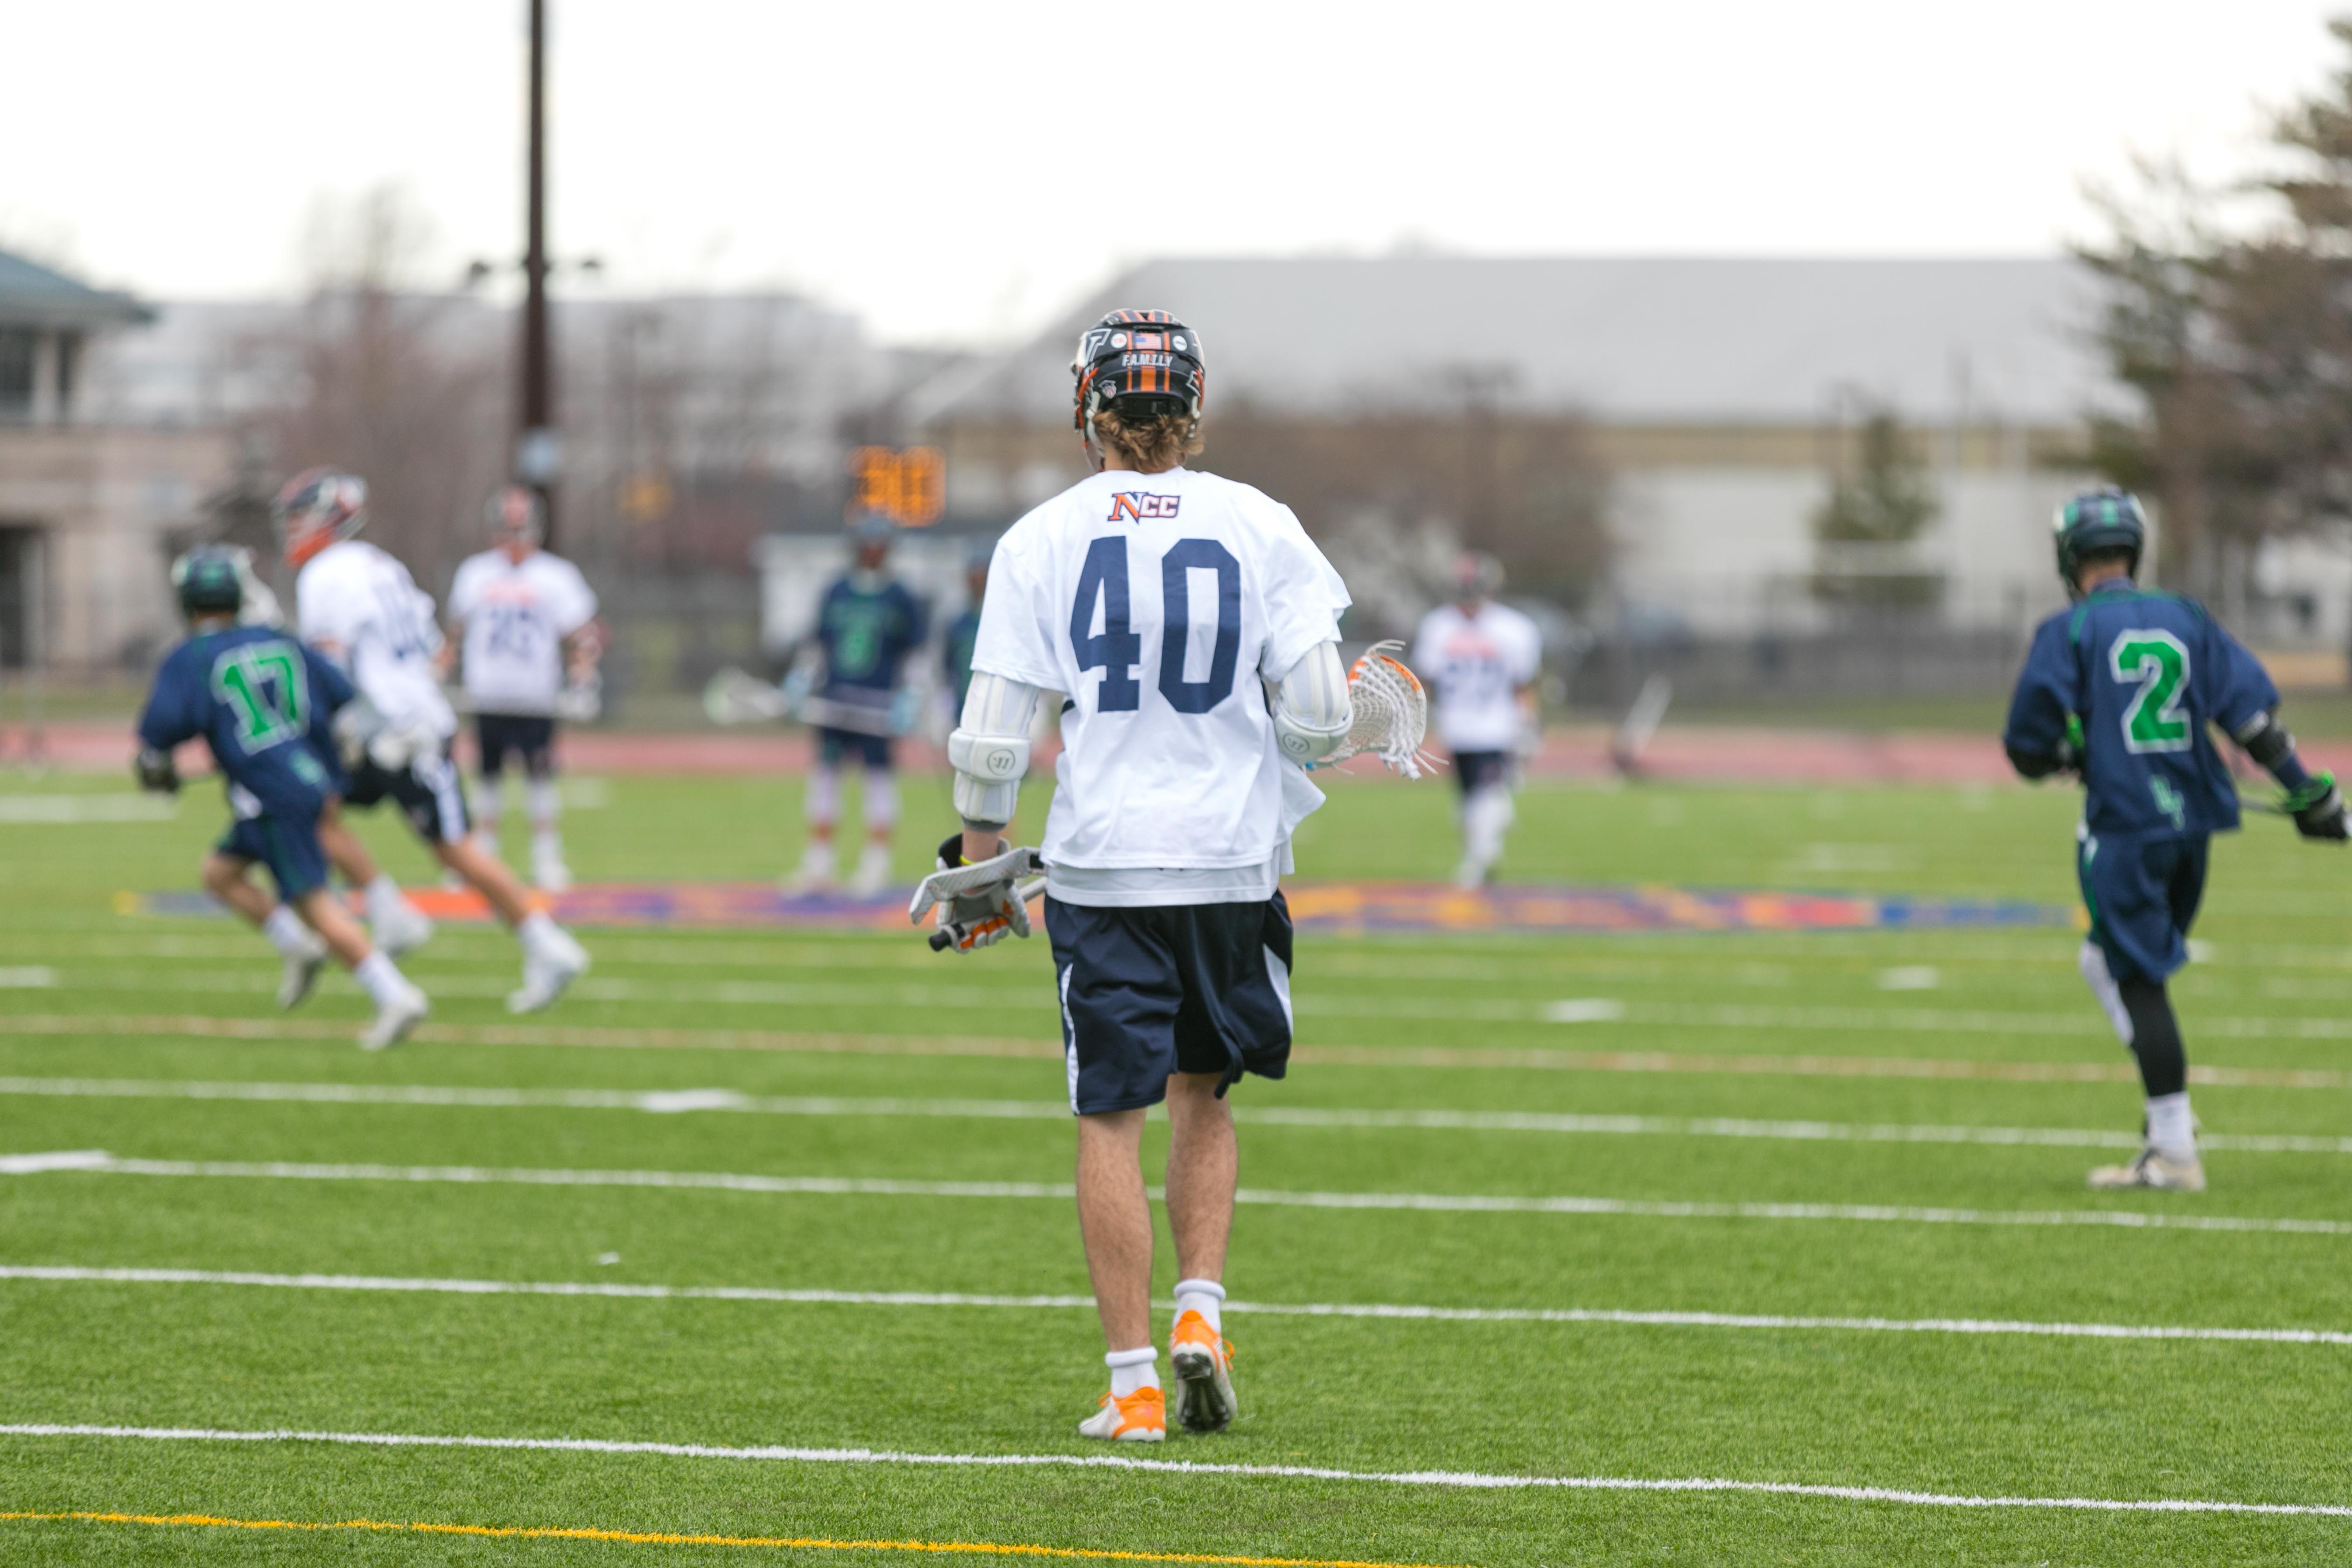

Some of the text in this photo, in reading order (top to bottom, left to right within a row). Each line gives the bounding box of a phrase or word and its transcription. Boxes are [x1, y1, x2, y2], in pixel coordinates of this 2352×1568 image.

[1107, 491, 1181, 525] NCC
[1070, 535, 1241, 714] 40
[210, 639, 311, 756] 17
[2109, 628, 2192, 754] 2
